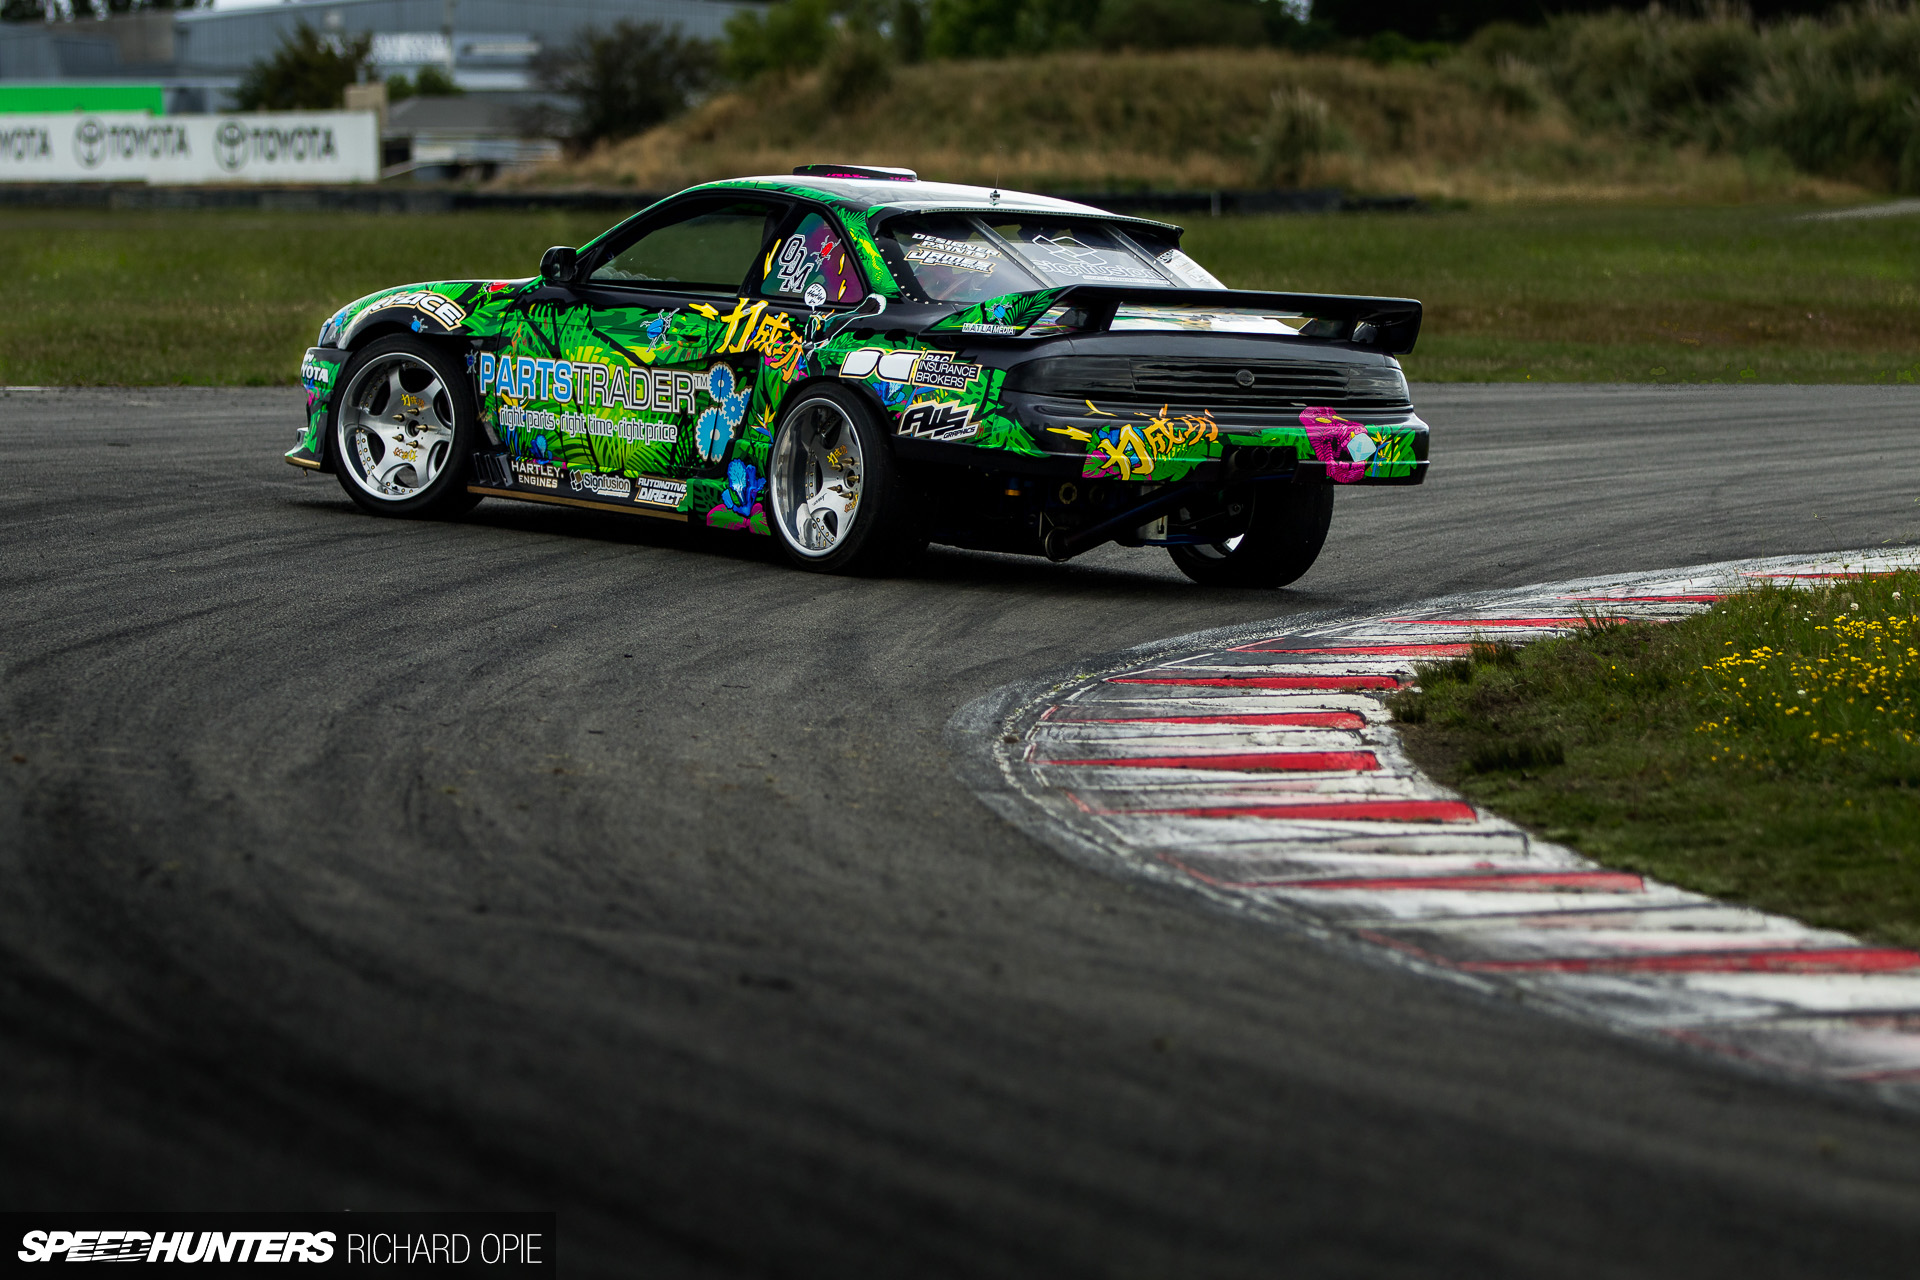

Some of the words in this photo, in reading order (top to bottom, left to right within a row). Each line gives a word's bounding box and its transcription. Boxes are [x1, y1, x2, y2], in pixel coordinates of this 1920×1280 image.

[0, 126, 52, 160] YOTA
[106, 125, 192, 160] TOYOTA
[249, 126, 338, 161] TOYOTA
[912, 233, 1000, 256] DESIGNER
[920, 240, 988, 259] PAINTS
[301, 363, 329, 383] YOTA
[918, 360, 977, 378] INSURANCE
[480, 352, 695, 414] PARTSTRADER
[915, 373, 965, 387] BROKERS
[499, 405, 525, 431] right
[525, 409, 555, 432] parts
[560, 411, 587, 438] right
[587, 414, 613, 437] time
[617, 417, 645, 444] right
[645, 420, 677, 445] price
[518, 475, 558, 489] ENGINES
[583, 472, 631, 493] Signfusion
[637, 477, 687, 492] AUTOMOTIVE
[640, 488, 684, 505] DIRECT
